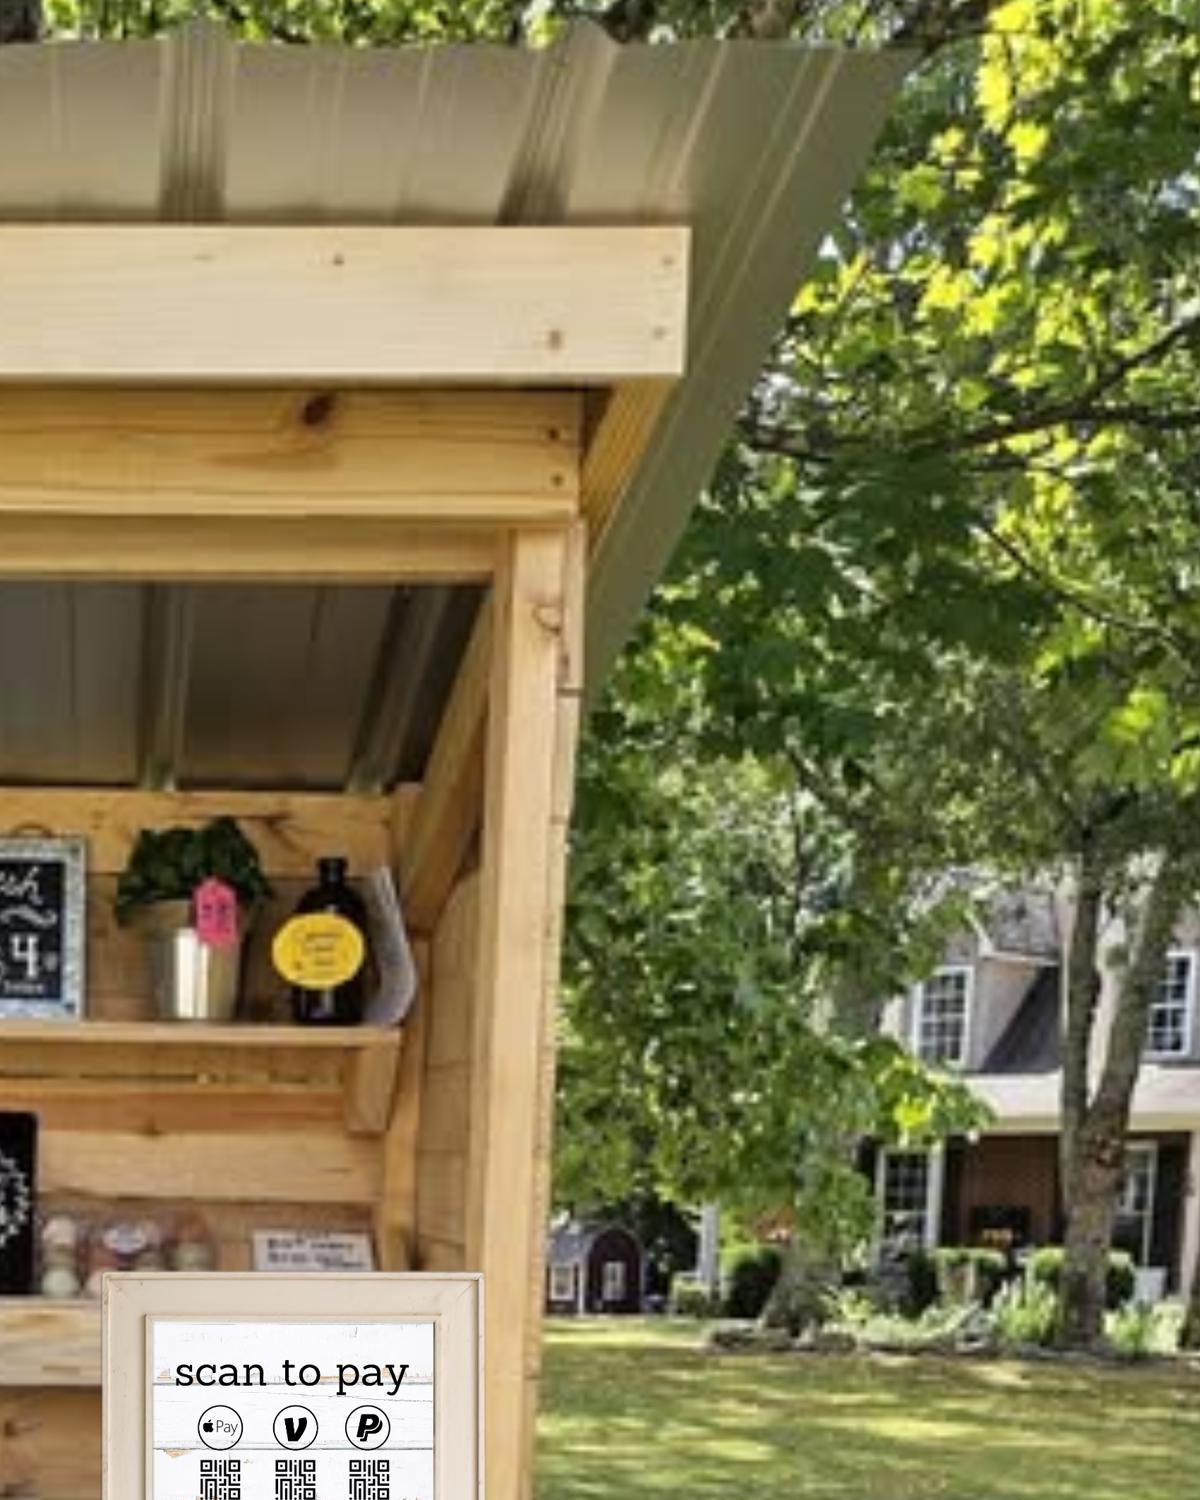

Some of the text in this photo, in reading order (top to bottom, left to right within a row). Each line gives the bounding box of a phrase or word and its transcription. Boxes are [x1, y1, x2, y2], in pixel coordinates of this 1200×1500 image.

[175, 1359, 410, 1396] scan to pay
[216, 1419, 238, 1437] Pay
